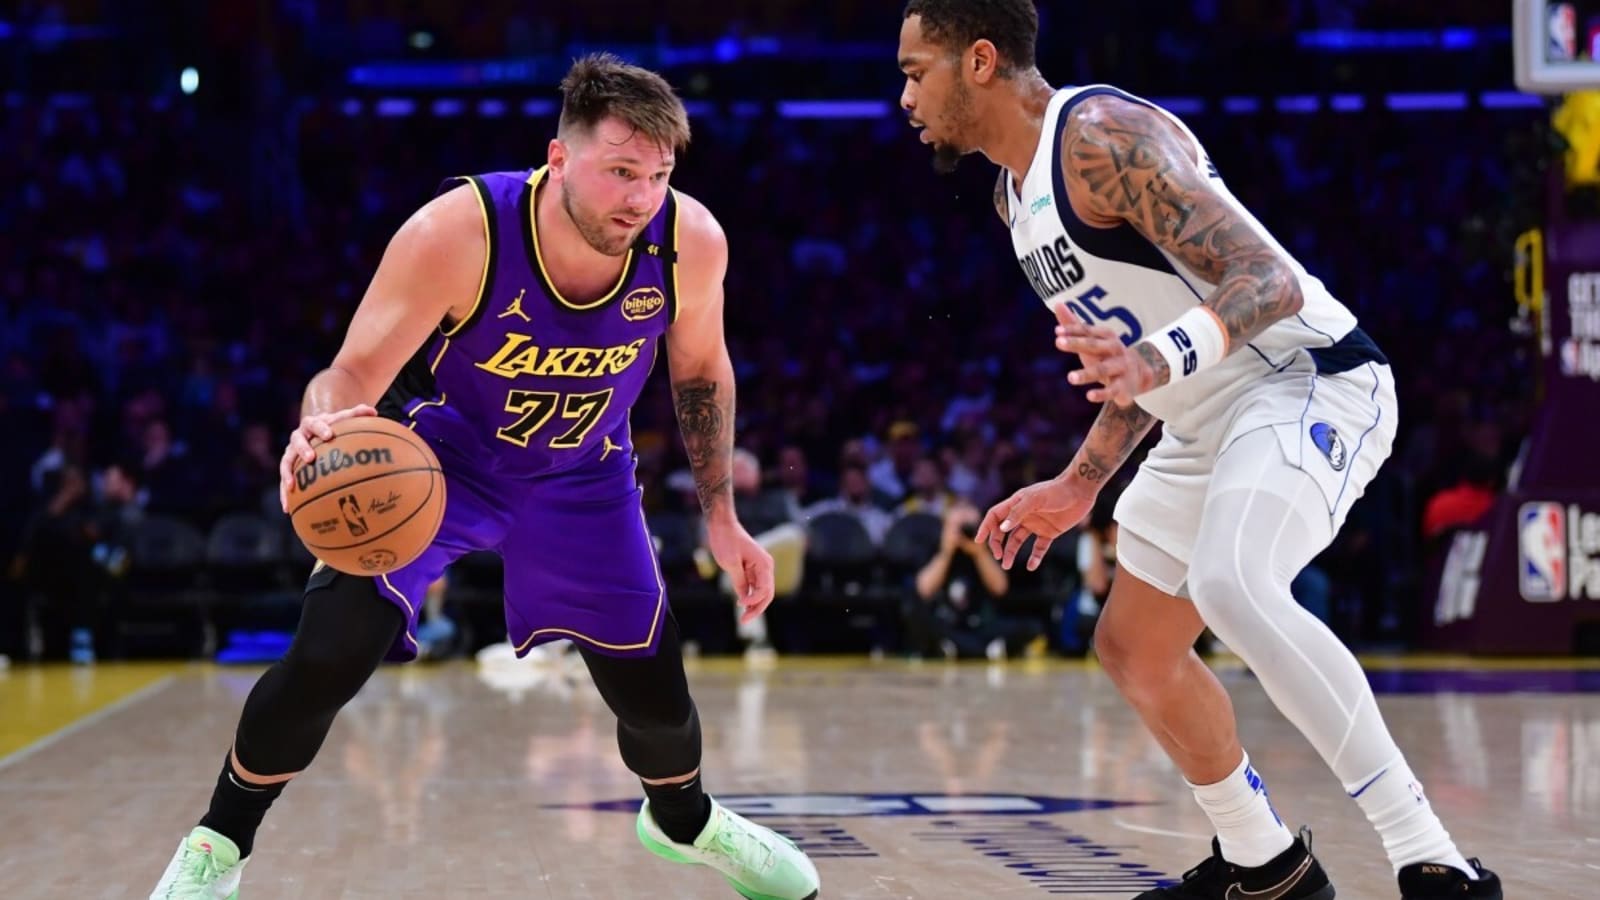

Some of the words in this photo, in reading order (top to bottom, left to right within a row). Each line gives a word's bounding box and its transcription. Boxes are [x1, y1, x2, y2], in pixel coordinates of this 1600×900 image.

[625, 296, 661, 310] bibigo
[474, 332, 646, 378] LAKERS
[1168, 326, 1197, 376] 25
[496, 387, 614, 448] 77
[296, 448, 393, 492] Wilson
